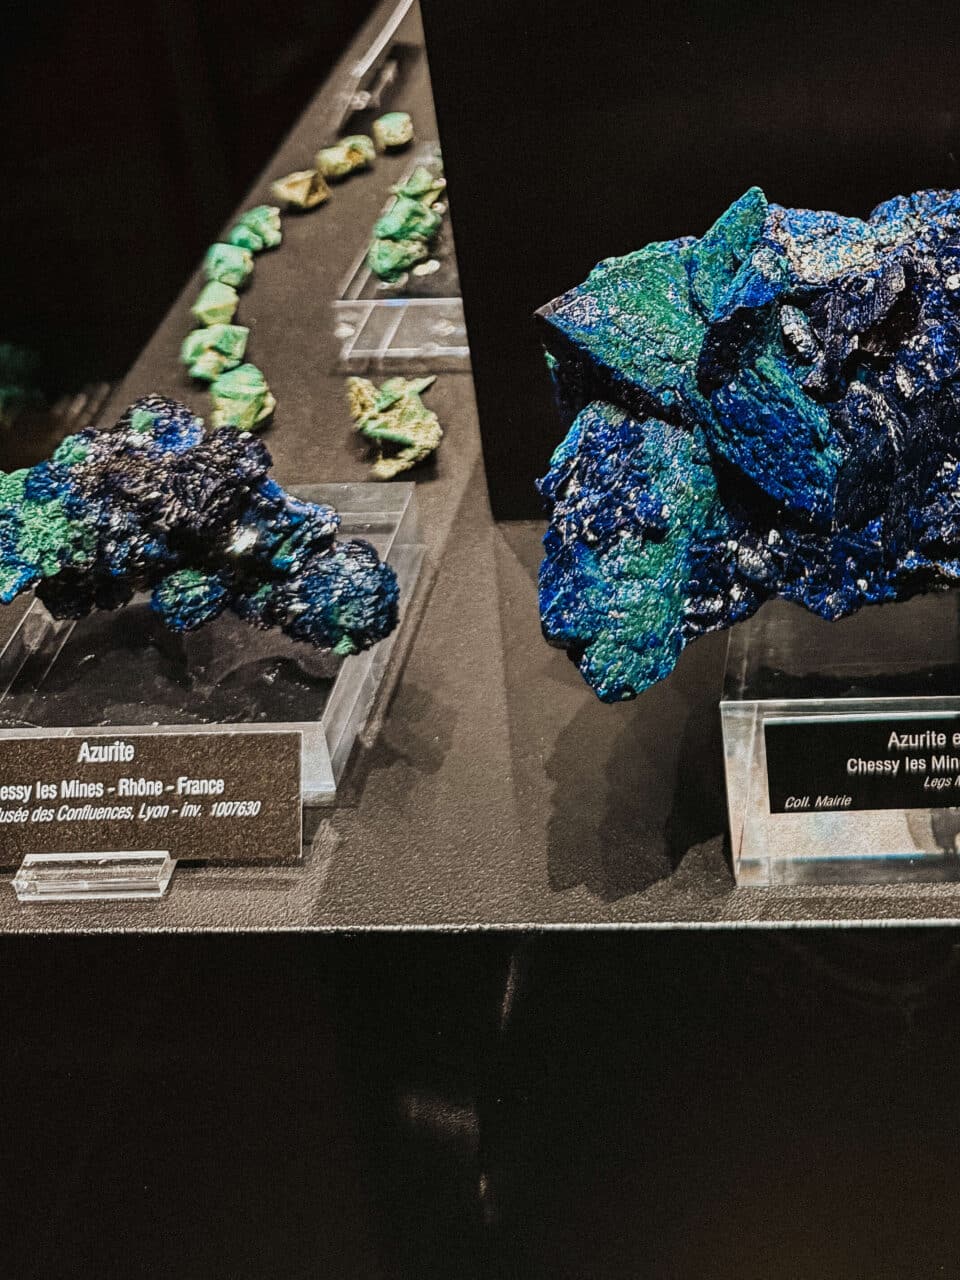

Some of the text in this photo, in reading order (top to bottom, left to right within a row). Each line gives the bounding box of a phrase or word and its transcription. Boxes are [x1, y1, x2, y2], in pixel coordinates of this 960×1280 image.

[887, 730, 947, 749] Azurite
[78, 741, 135, 762] Azurite
[846, 758, 900, 775] Chessy
[905, 757, 926, 772] les
[0, 786, 32, 803] essy
[36, 782, 57, 798] les
[61, 780, 104, 798] Mines
[118, 778, 163, 796] Rhône
[177, 776, 224, 795] France
[924, 775, 952, 789] Legs
[31, 806, 54, 821] des
[57, 804, 135, 820] Confluences,
[138, 802, 169, 821] Lyon
[180, 802, 202, 818] inv.
[210, 800, 261, 817] 1007630
[785, 794, 852, 808] Coll. Mairie
